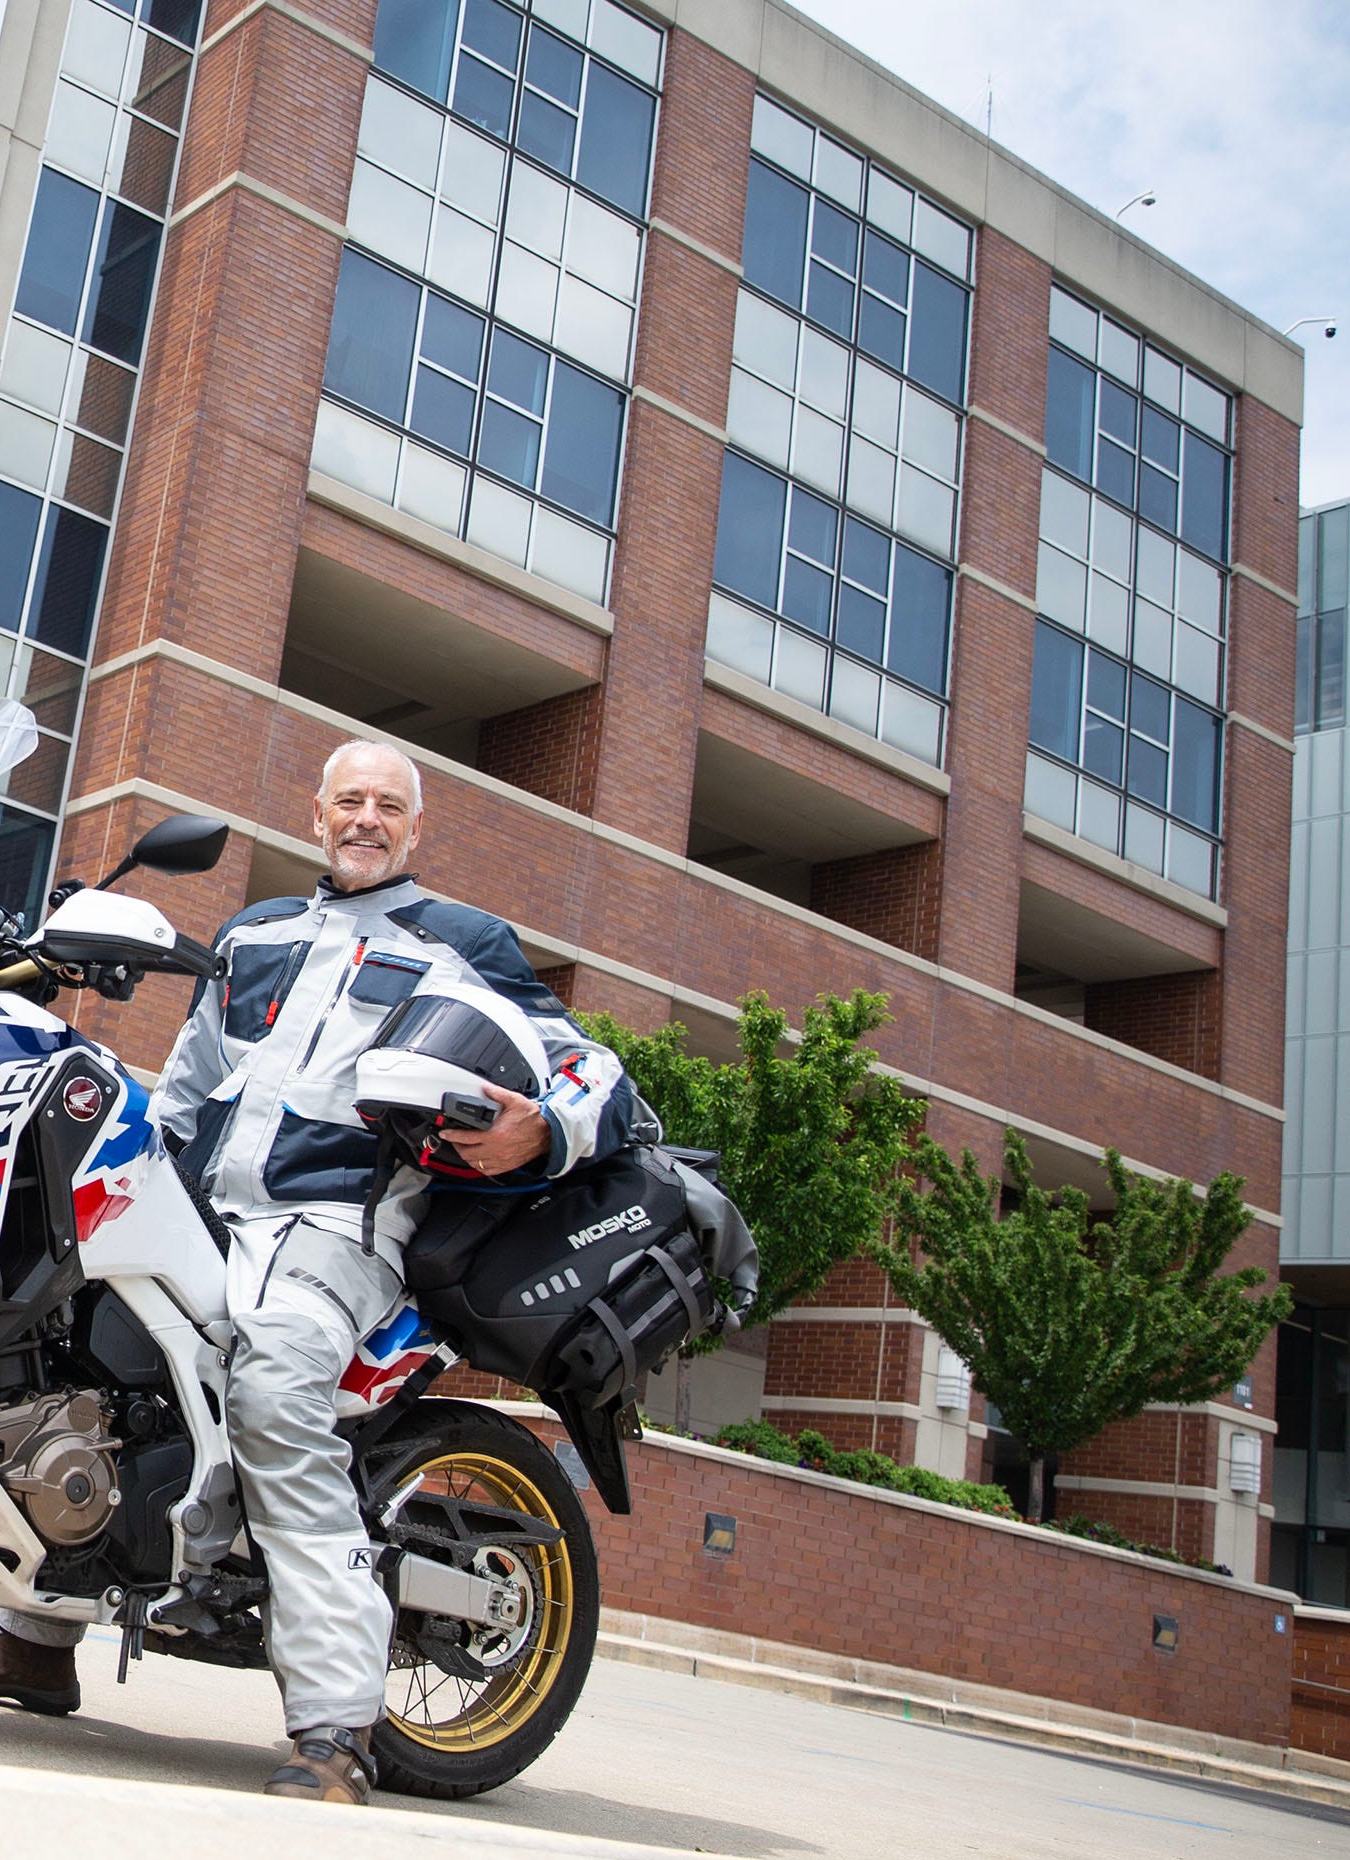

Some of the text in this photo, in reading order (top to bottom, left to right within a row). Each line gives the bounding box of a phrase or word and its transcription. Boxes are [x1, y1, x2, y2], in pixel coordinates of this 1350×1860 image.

[68, 1103, 95, 1113] HONDA
[567, 1205, 647, 1249] MOSKO
[627, 1218, 652, 1233] MOTO
